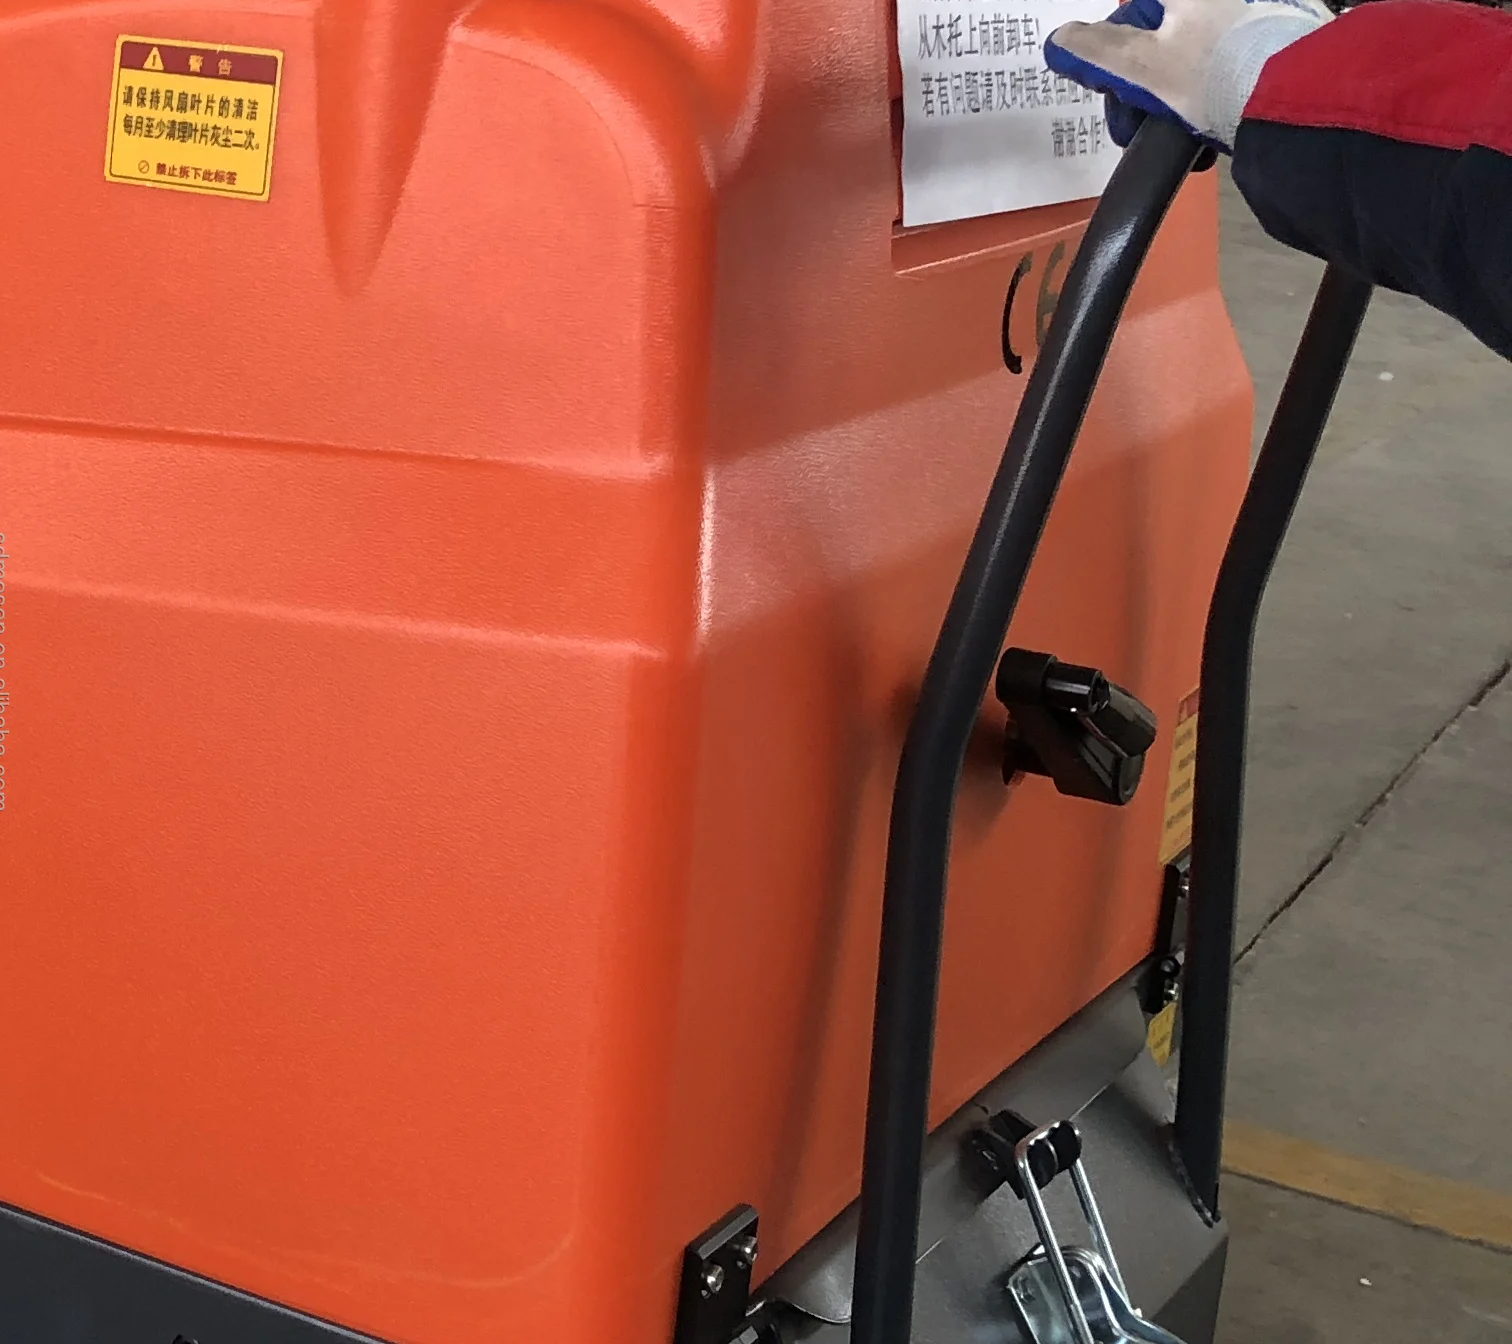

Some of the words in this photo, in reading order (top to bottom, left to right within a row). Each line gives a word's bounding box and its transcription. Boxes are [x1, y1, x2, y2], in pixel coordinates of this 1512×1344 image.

[122, 85, 259, 122] 请保持风扇叶片的清洁
